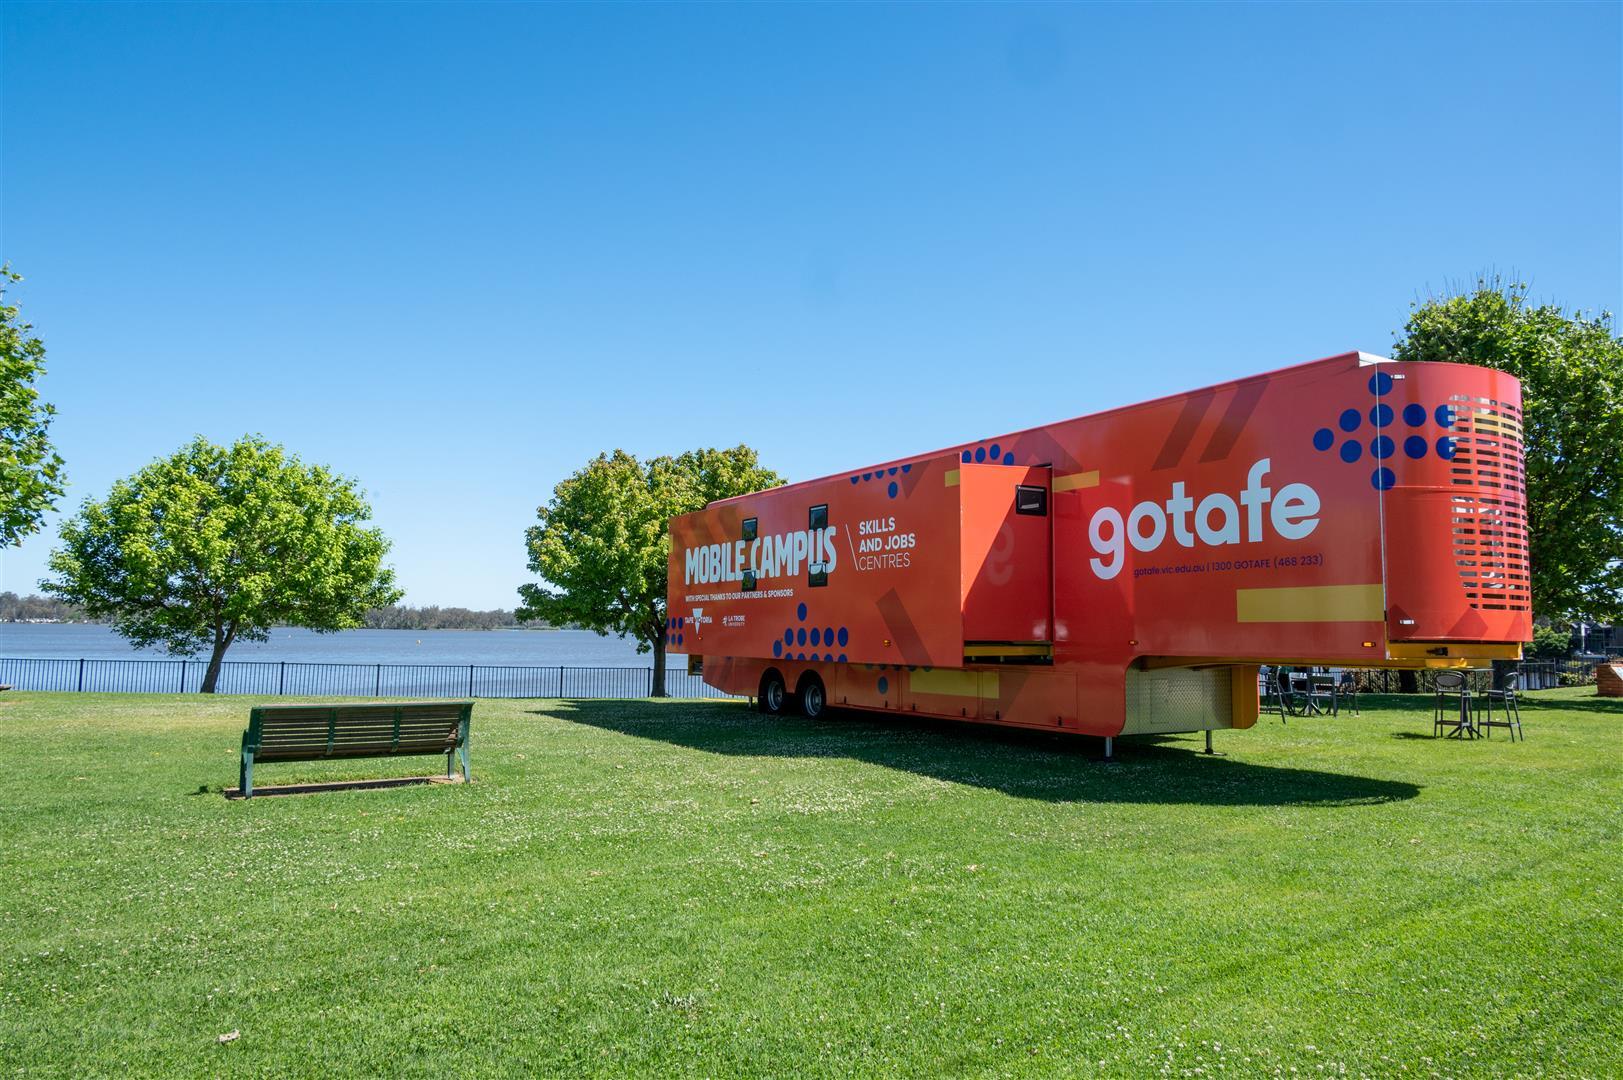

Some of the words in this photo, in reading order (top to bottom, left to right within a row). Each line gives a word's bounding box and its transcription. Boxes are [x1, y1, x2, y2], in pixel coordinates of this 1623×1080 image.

[859, 516, 896, 535] SKILLS
[1088, 457, 1321, 580] gotafe
[859, 537, 882, 553] AND
[884, 532, 916, 550] JOBS
[685, 540, 745, 586] MOBILE
[751, 526, 837, 579] CAMPUS
[859, 552, 911, 571] CENTRES
[1133, 564, 1205, 578] gotafe.vic.edu.au
[1212, 560, 1232, 571] 1300
[1233, 559, 1271, 570] GOTAFE
[1300, 554, 1324, 567] 233)
[696, 594, 709, 602] SPECIAL
[742, 590, 763, 599] PARTNERS
[768, 588, 793, 598] SPONSORS
